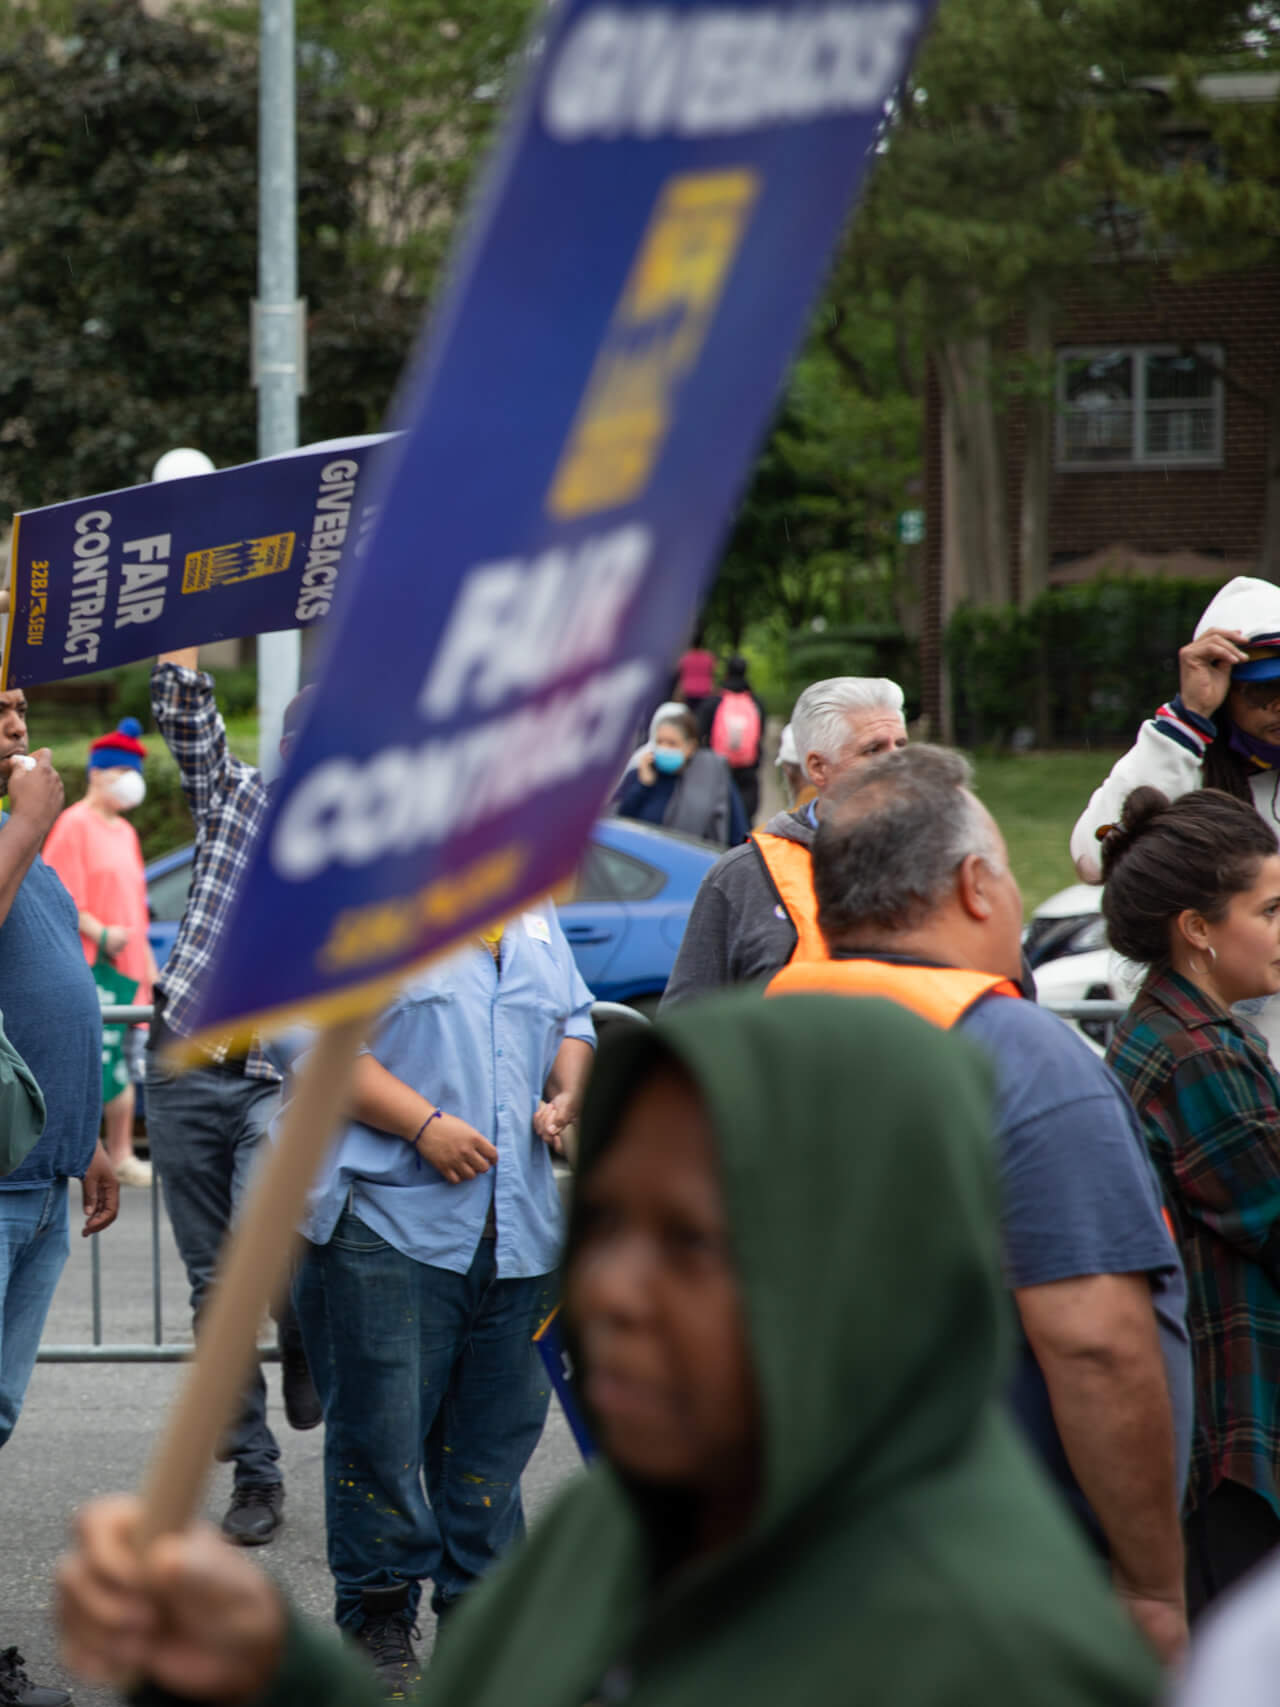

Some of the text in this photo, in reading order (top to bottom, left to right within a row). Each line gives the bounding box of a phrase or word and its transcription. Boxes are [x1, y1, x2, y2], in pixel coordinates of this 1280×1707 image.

[27, 560, 49, 646] 32BJ SEIU
[63, 510, 112, 665] CONTRACT
[115, 533, 172, 629] FAIR
[295, 459, 359, 622] GIVEBACKS
